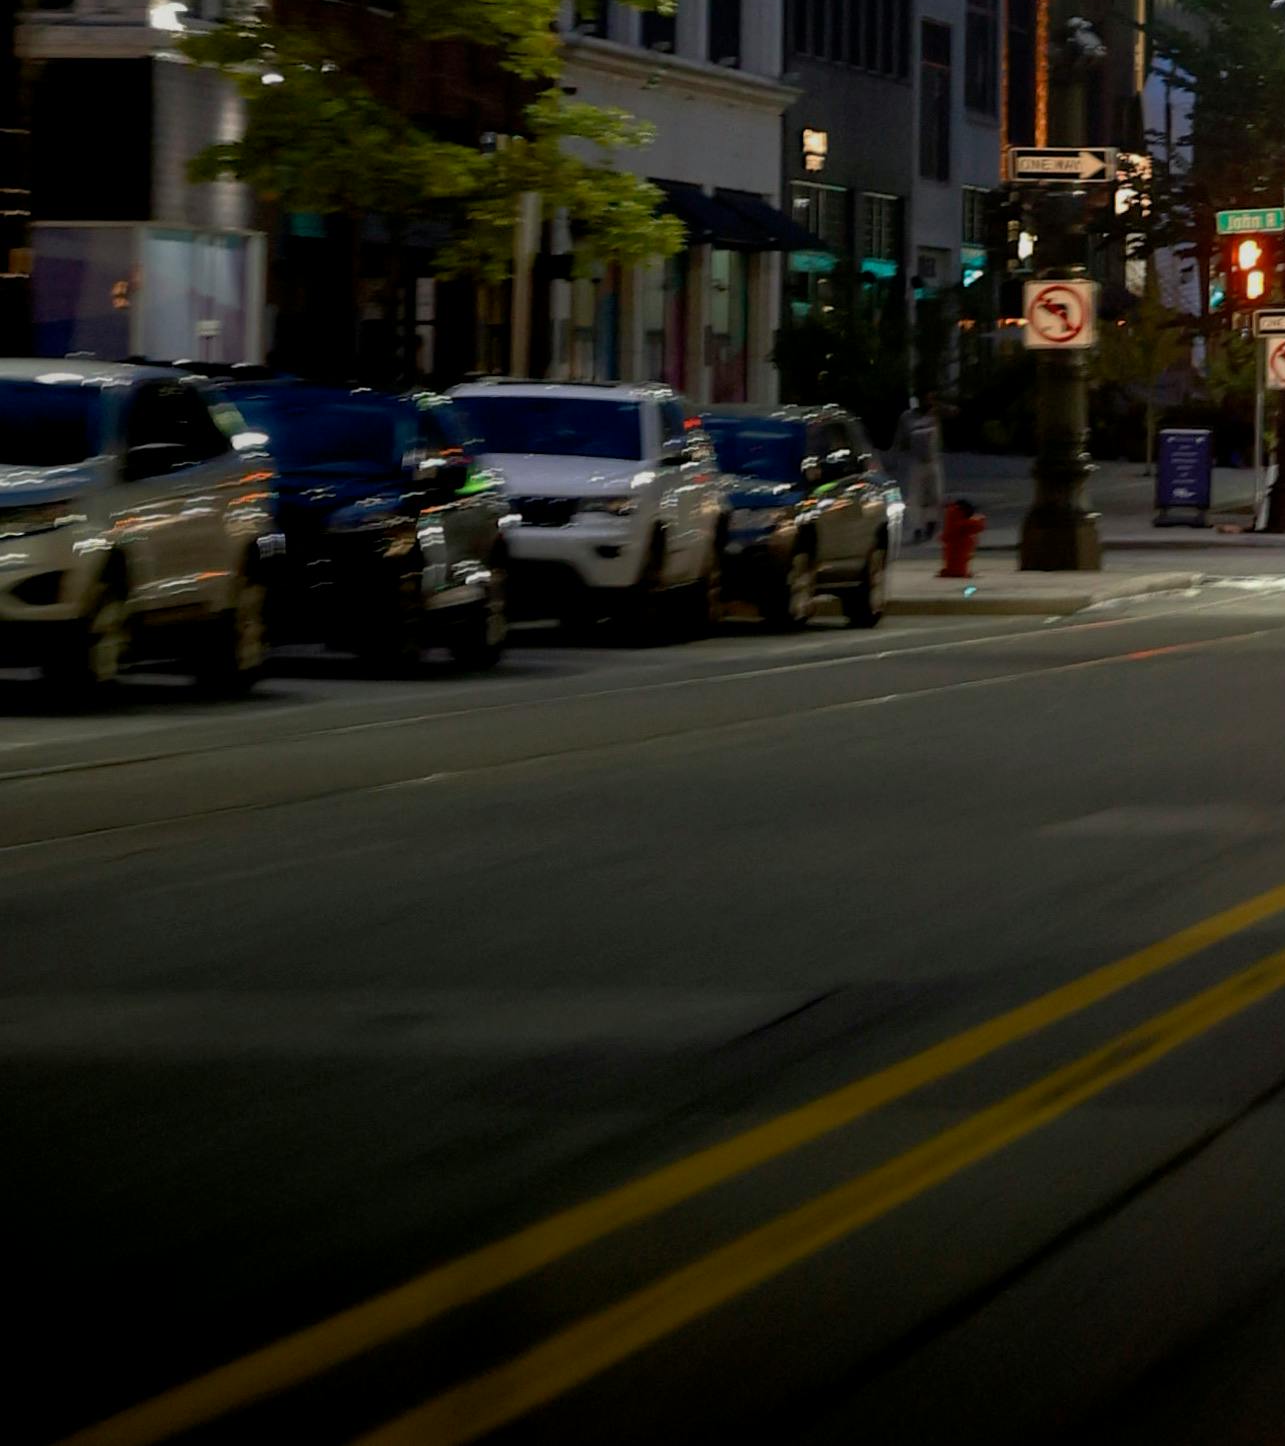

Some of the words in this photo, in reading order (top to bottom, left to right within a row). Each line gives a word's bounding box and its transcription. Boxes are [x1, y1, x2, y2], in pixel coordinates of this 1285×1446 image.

[1017, 157, 1055, 171] ONE
[1056, 157, 1083, 171] WAY
[1227, 215, 1262, 230] John
